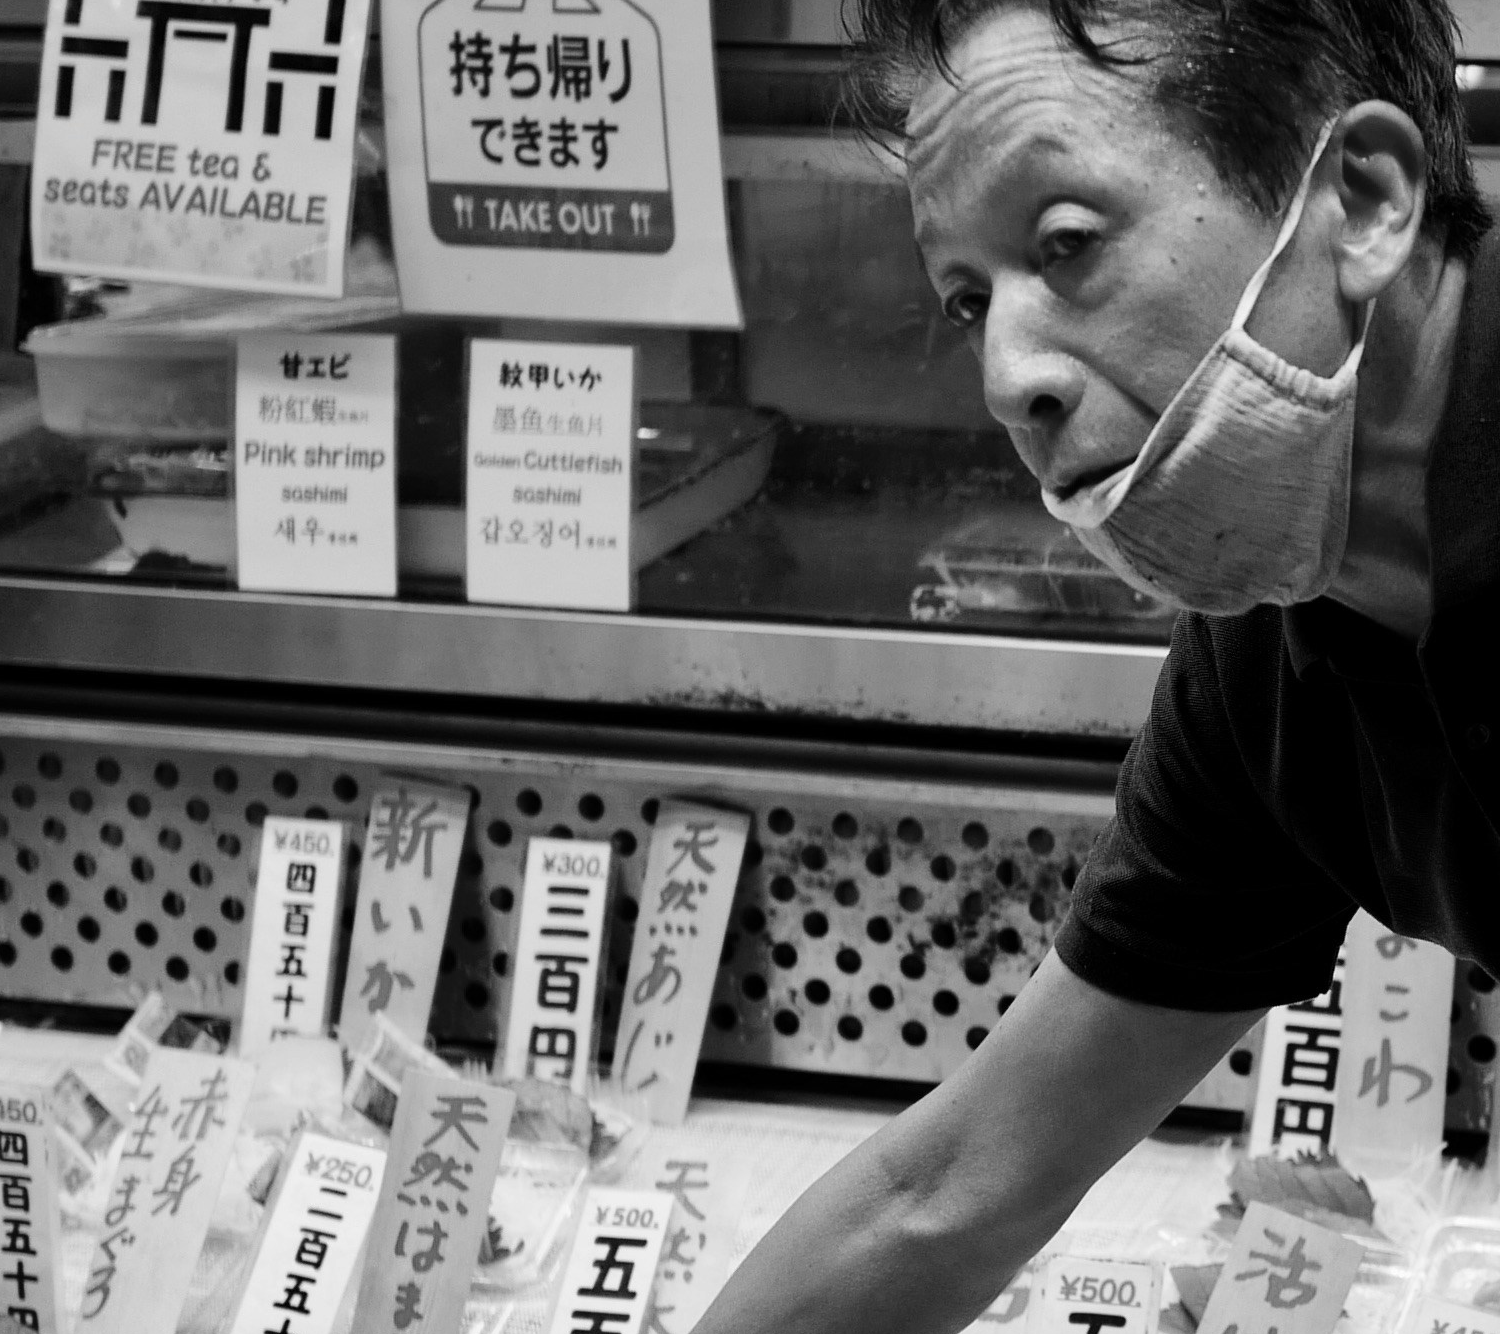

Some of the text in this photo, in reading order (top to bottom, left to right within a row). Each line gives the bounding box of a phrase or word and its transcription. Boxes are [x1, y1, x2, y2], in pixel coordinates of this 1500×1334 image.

[448, 30, 633, 104] 持ち帰り
[91, 139, 178, 174] FREE
[187, 143, 241, 178] tea
[469, 114, 620, 171] できます
[43, 177, 328, 226] seats AVAILABLE
[485, 199, 617, 237] TAKE OUT
[279, 350, 351, 380] 甘エビ
[499, 360, 603, 392] 紋甲いか
[243, 440, 387, 472] Pink shrimp
[523, 449, 623, 476] Cuttlefish
[281, 485, 349, 504] sashimi
[511, 485, 582, 507] sashimi
[360, 792, 449, 1014] 新いか
[270, 861, 317, 1041] 四百五十
[621, 818, 719, 1096] 天然あじ
[528, 884, 592, 1085] 三百円
[84, 1084, 169, 1320] 生まぐろ
[1058, 1273, 1143, 1308] ¥500.
